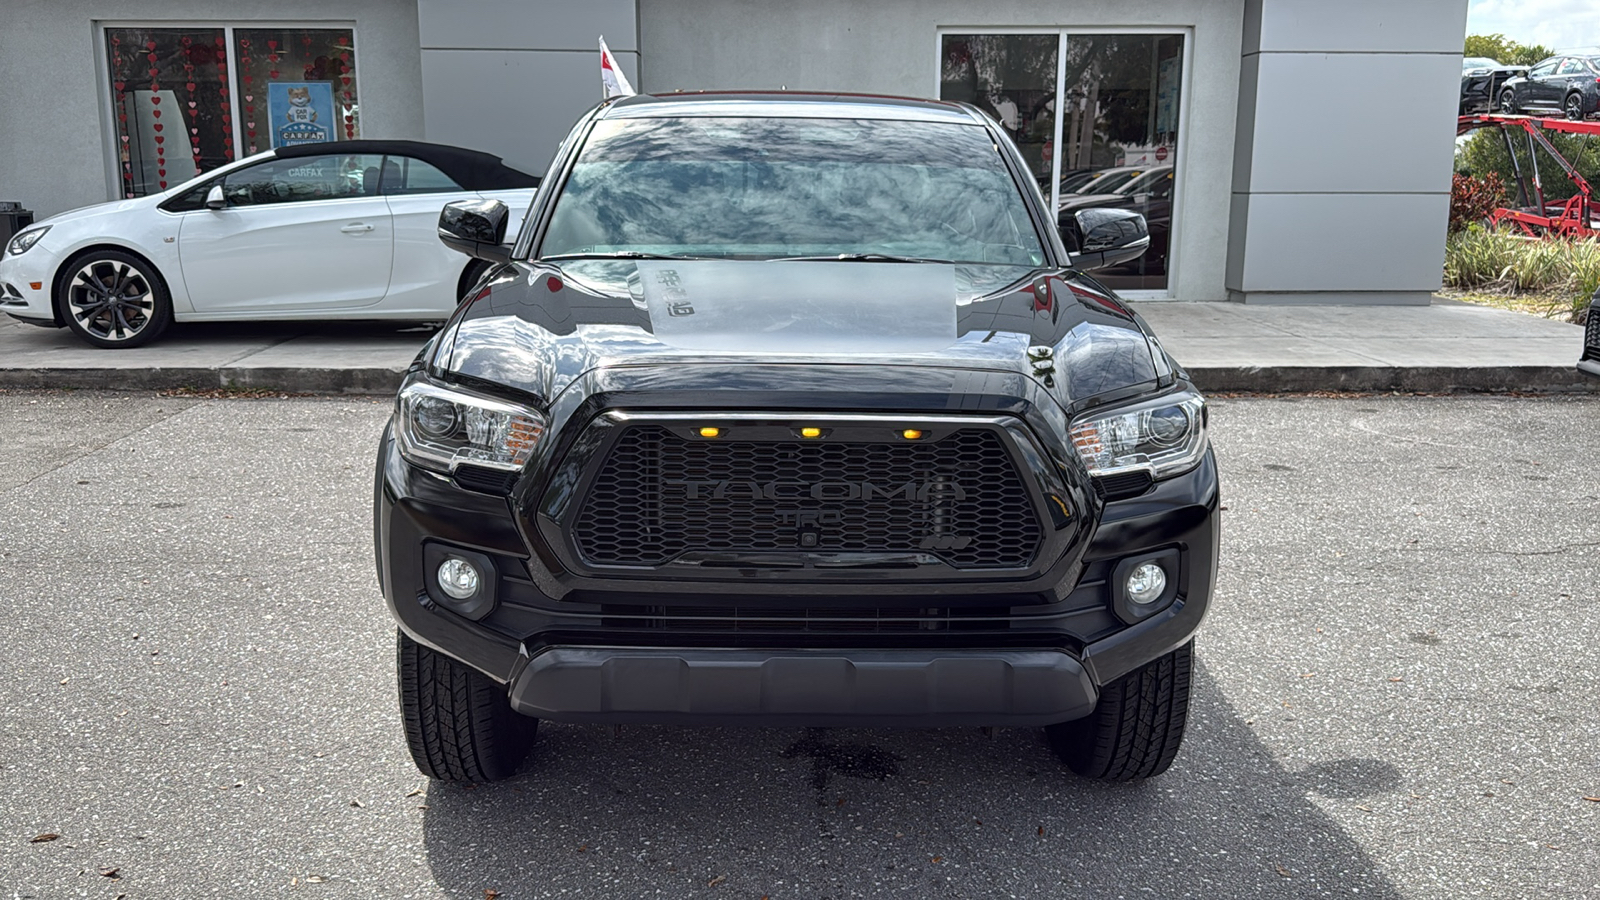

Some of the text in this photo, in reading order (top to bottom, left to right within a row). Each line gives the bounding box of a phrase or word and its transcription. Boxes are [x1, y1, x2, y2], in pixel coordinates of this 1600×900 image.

[282, 132, 325, 140] CARFAX
[288, 168, 323, 177] CARFAX
[666, 479, 966, 501] TACOMA
[774, 509, 842, 528] TRD
